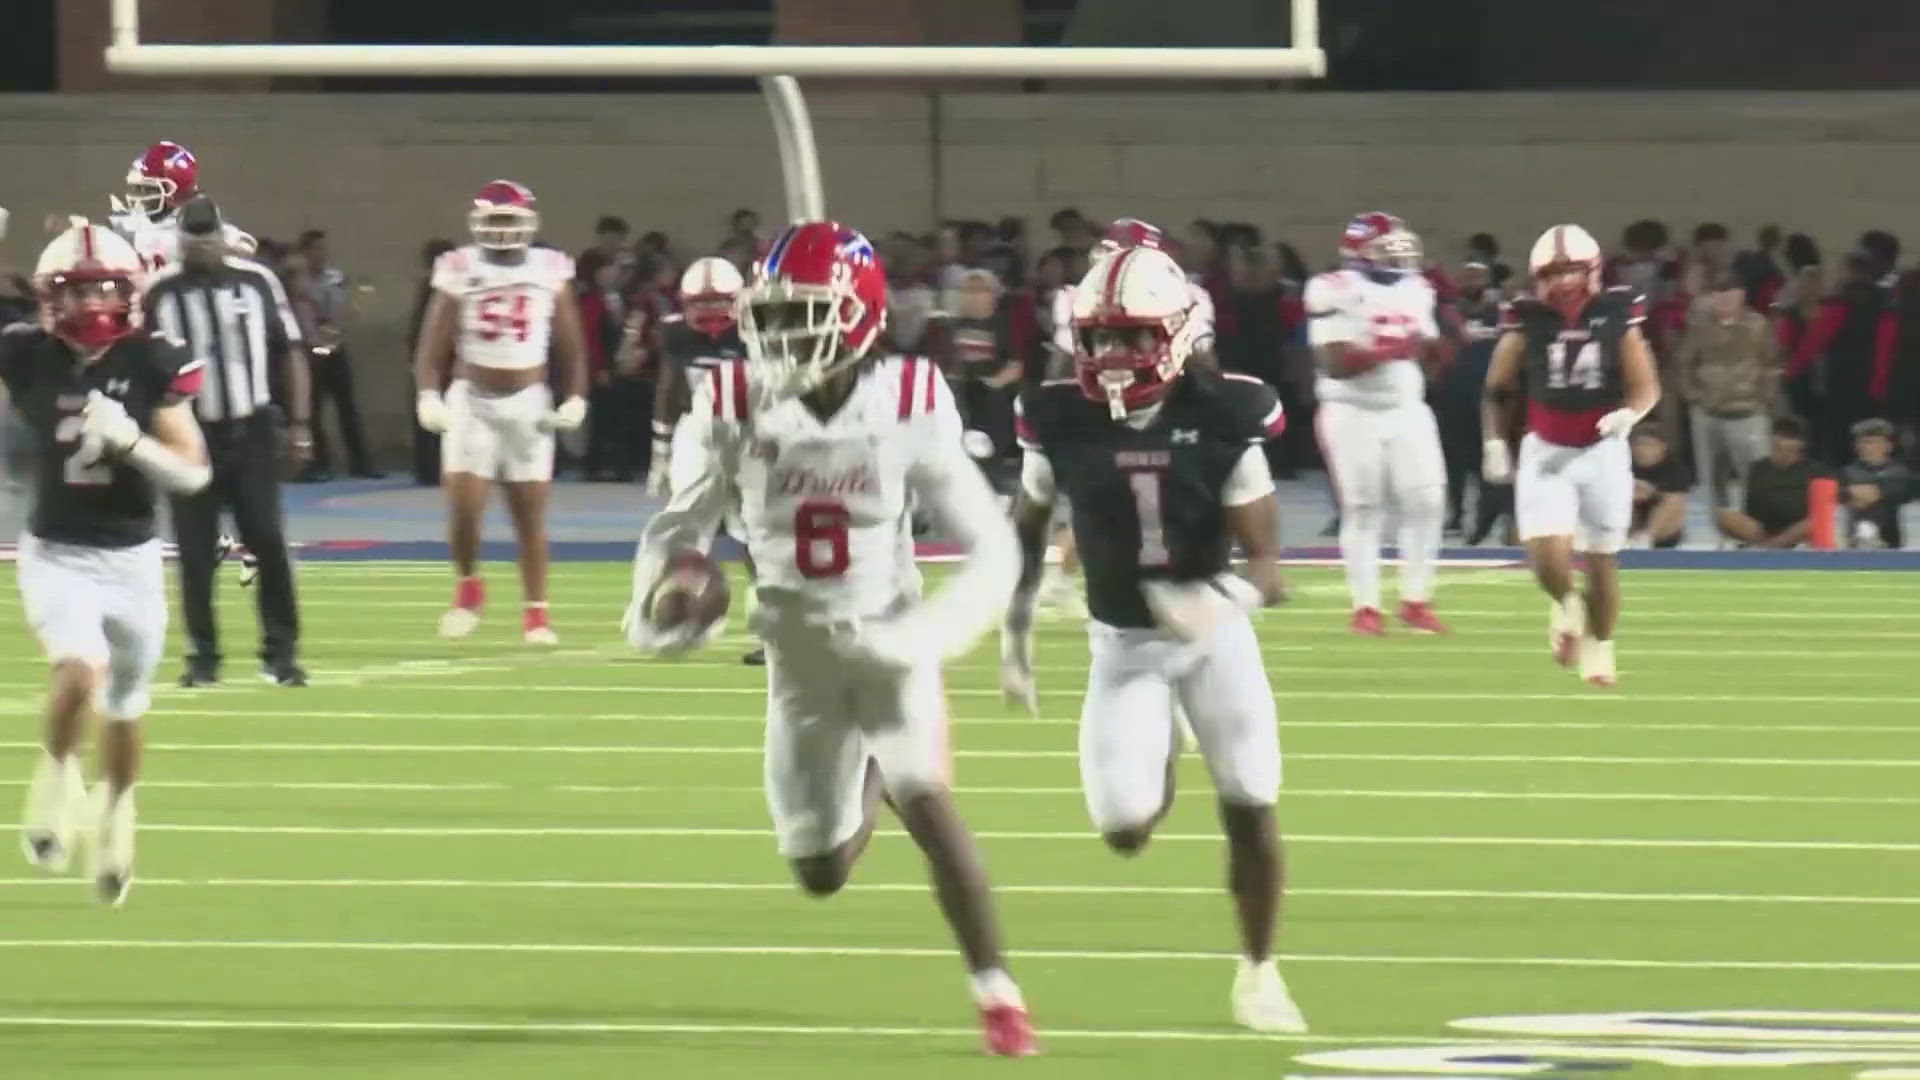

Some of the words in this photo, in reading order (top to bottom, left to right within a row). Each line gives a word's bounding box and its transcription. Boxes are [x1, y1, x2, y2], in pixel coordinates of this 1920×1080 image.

[478, 292, 529, 342] 54
[1547, 342, 1602, 389] 14
[795, 499, 849, 577] 6
[1130, 471, 1172, 567] 1
